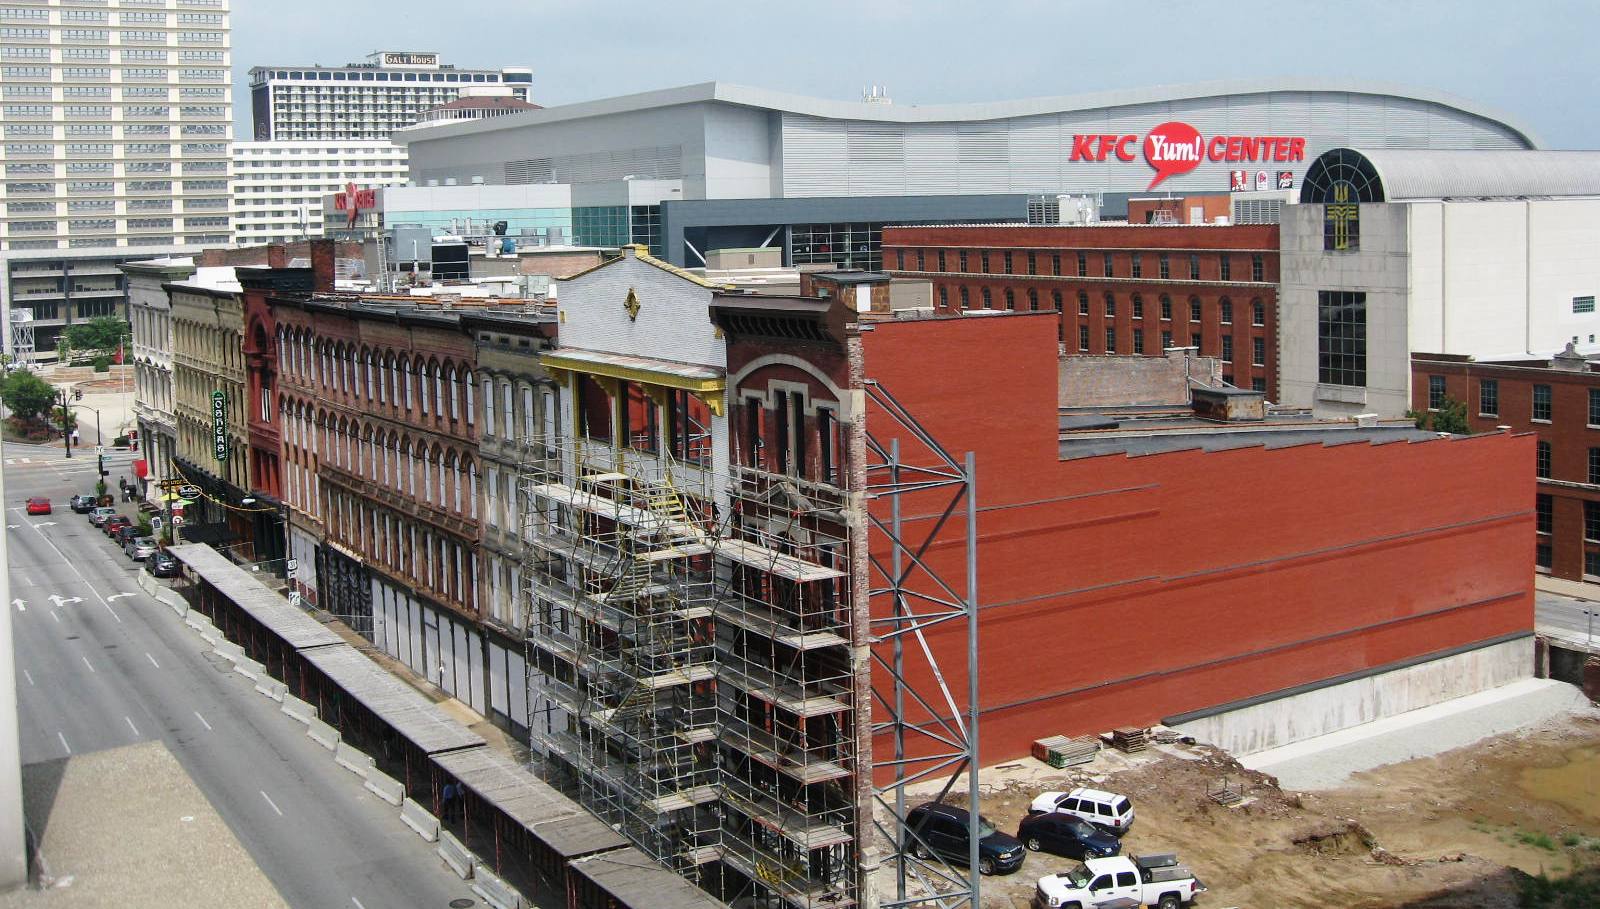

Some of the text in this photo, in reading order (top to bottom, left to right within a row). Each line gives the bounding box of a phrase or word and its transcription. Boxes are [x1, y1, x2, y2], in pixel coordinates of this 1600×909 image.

[386, 54, 435, 65] GALT HOUSE
[1069, 134, 1306, 162] KFC Yum! CENTER
